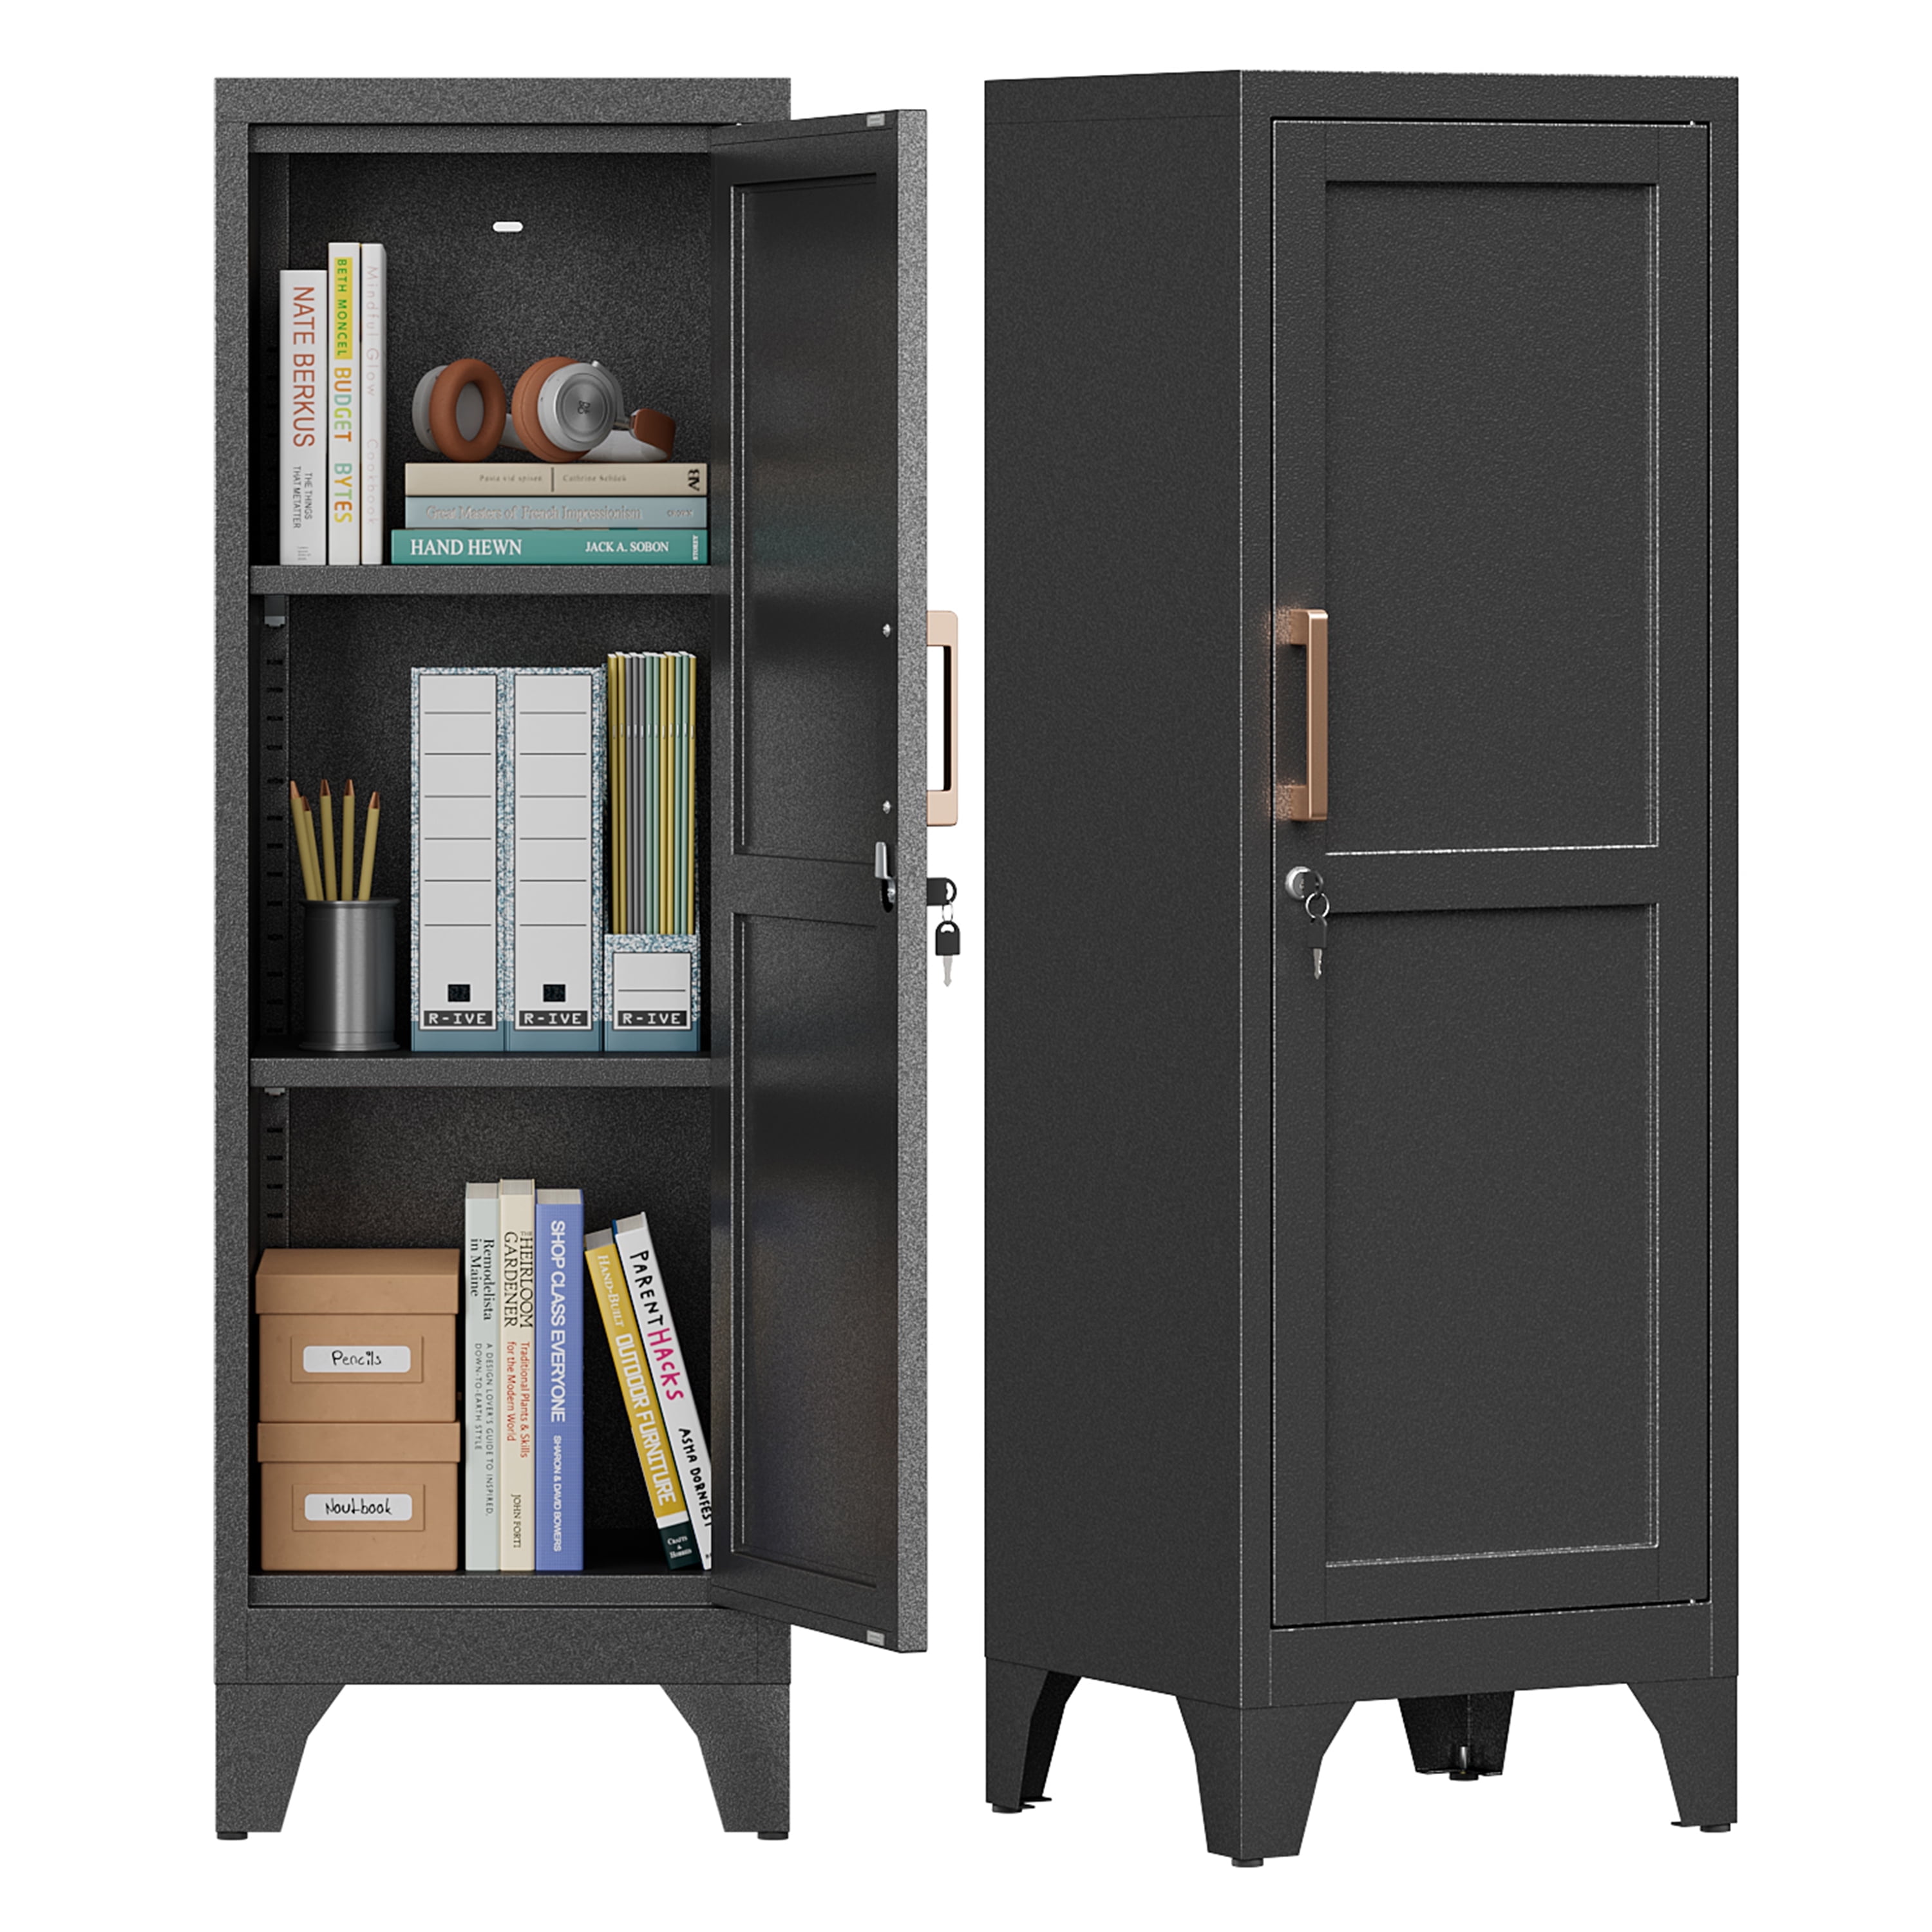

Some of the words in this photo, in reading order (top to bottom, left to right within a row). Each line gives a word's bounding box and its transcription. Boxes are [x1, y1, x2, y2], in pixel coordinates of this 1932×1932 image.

[337, 259, 347, 292] BETH
[293, 287, 315, 345] NATE
[366, 265, 379, 337] Mindful
[337, 299, 347, 355] MONCEL
[366, 348, 379, 396] Glow
[293, 354, 315, 447] BERKUS
[334, 368, 352, 442] BUDGET
[293, 466, 301, 485] THAT
[304, 473, 313, 488] THE
[366, 439, 379, 525] Cookbook
[293, 487, 301, 529] METATTER
[304, 490, 313, 520] THINGS
[334, 463, 352, 523] BYTES
[426, 505, 456, 520] Great
[458, 505, 502, 520] Masters
[503, 505, 517, 520] of
[520, 505, 560, 520] French
[561, 505, 642, 523] Impressionism
[410, 539, 464, 556] HAND
[468, 539, 522, 556] HEWN
[585, 542, 614, 553] JACK
[616, 542, 628, 553] A.
[630, 542, 670, 553] SOBON
[429, 1012, 487, 1025] R-IVE
[524, 1012, 582, 1025] R-IVE
[623, 1012, 681, 1025] R-IVE
[470, 1238, 482, 1251] in
[551, 1220, 566, 1269] SHOP
[470, 1255, 482, 1297] Maine
[483, 1239, 495, 1320] Remodelista
[504, 1231, 518, 1328] GARDENER
[520, 1237, 533, 1328] HEIRLOOM
[629, 1249, 664, 1326] PARENT
[551, 1271, 566, 1327] CLASS
[331, 1350, 383, 1366] Pencils
[506, 1341, 516, 1354] for
[474, 1343, 482, 1421] DOWN-TO-EARTH
[486, 1352, 494, 1385] DESIGN
[506, 1358, 516, 1372] the
[520, 1341, 530, 1391] Traditional
[551, 1330, 566, 1423] EVERYONE
[597, 1255, 625, 1327] HAND-BUILT
[615, 1332, 650, 1409] OUTDOOR
[635, 1410, 677, 1506] FURNITURE
[486, 1389, 494, 1425] LOVER'S
[506, 1374, 516, 1411] Modern
[520, 1393, 530, 1422] Plants
[474, 1425, 482, 1450] STYLE
[486, 1428, 494, 1455] GUIDE
[506, 1413, 516, 1441] World
[520, 1434, 530, 1458] Skills
[553, 1435, 562, 1474] SHARON
[486, 1459, 494, 1471] TO
[511, 1494, 522, 1519] JOHN
[553, 1483, 562, 1510] DAVID
[513, 1520, 522, 1548] FORTI
[553, 1511, 562, 1552] BOWERS
